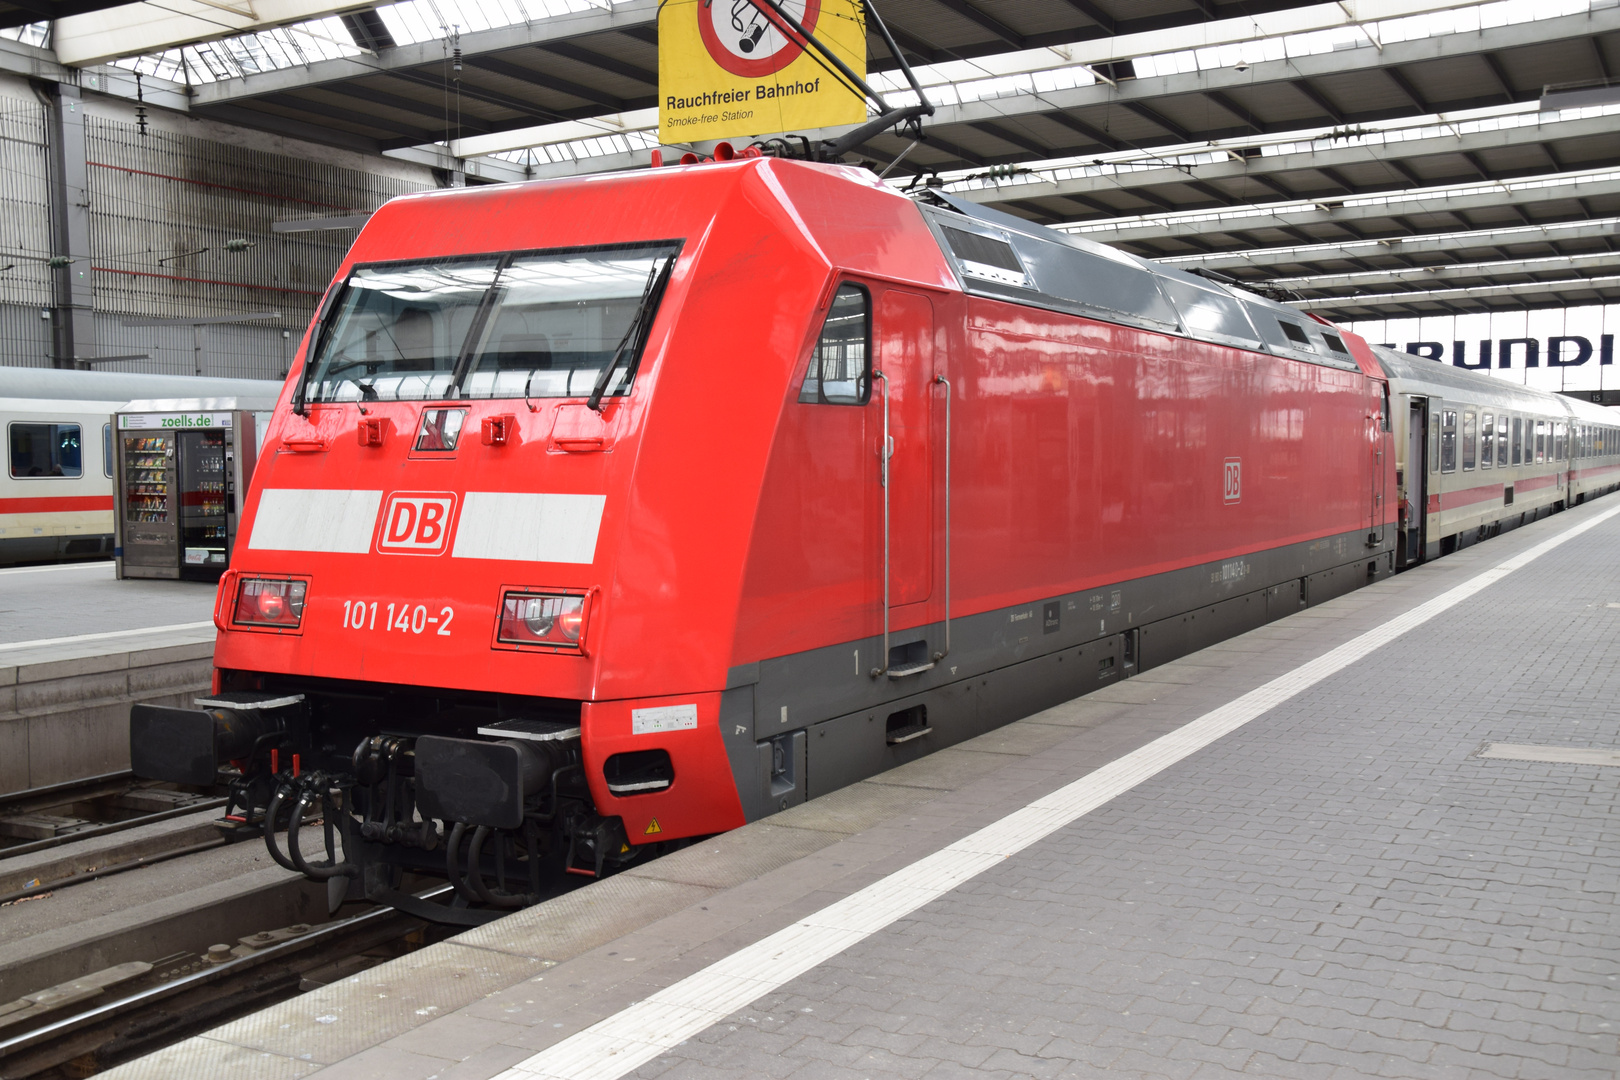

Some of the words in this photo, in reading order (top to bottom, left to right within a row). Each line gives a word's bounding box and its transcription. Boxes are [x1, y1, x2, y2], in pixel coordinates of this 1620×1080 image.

[667, 89, 750, 110] Rauchfreier
[756, 78, 820, 100] Bahnhof
[667, 113, 718, 128] Smoke-free
[721, 109, 754, 122] Station
[1592, 394, 1601, 402] 15
[161, 414, 211, 427] zoells.de
[1226, 465, 1240, 496] DB
[387, 502, 445, 544] DB
[343, 600, 378, 631] 101
[386, 602, 454, 636] 140-2
[853, 649, 858, 675] 1
